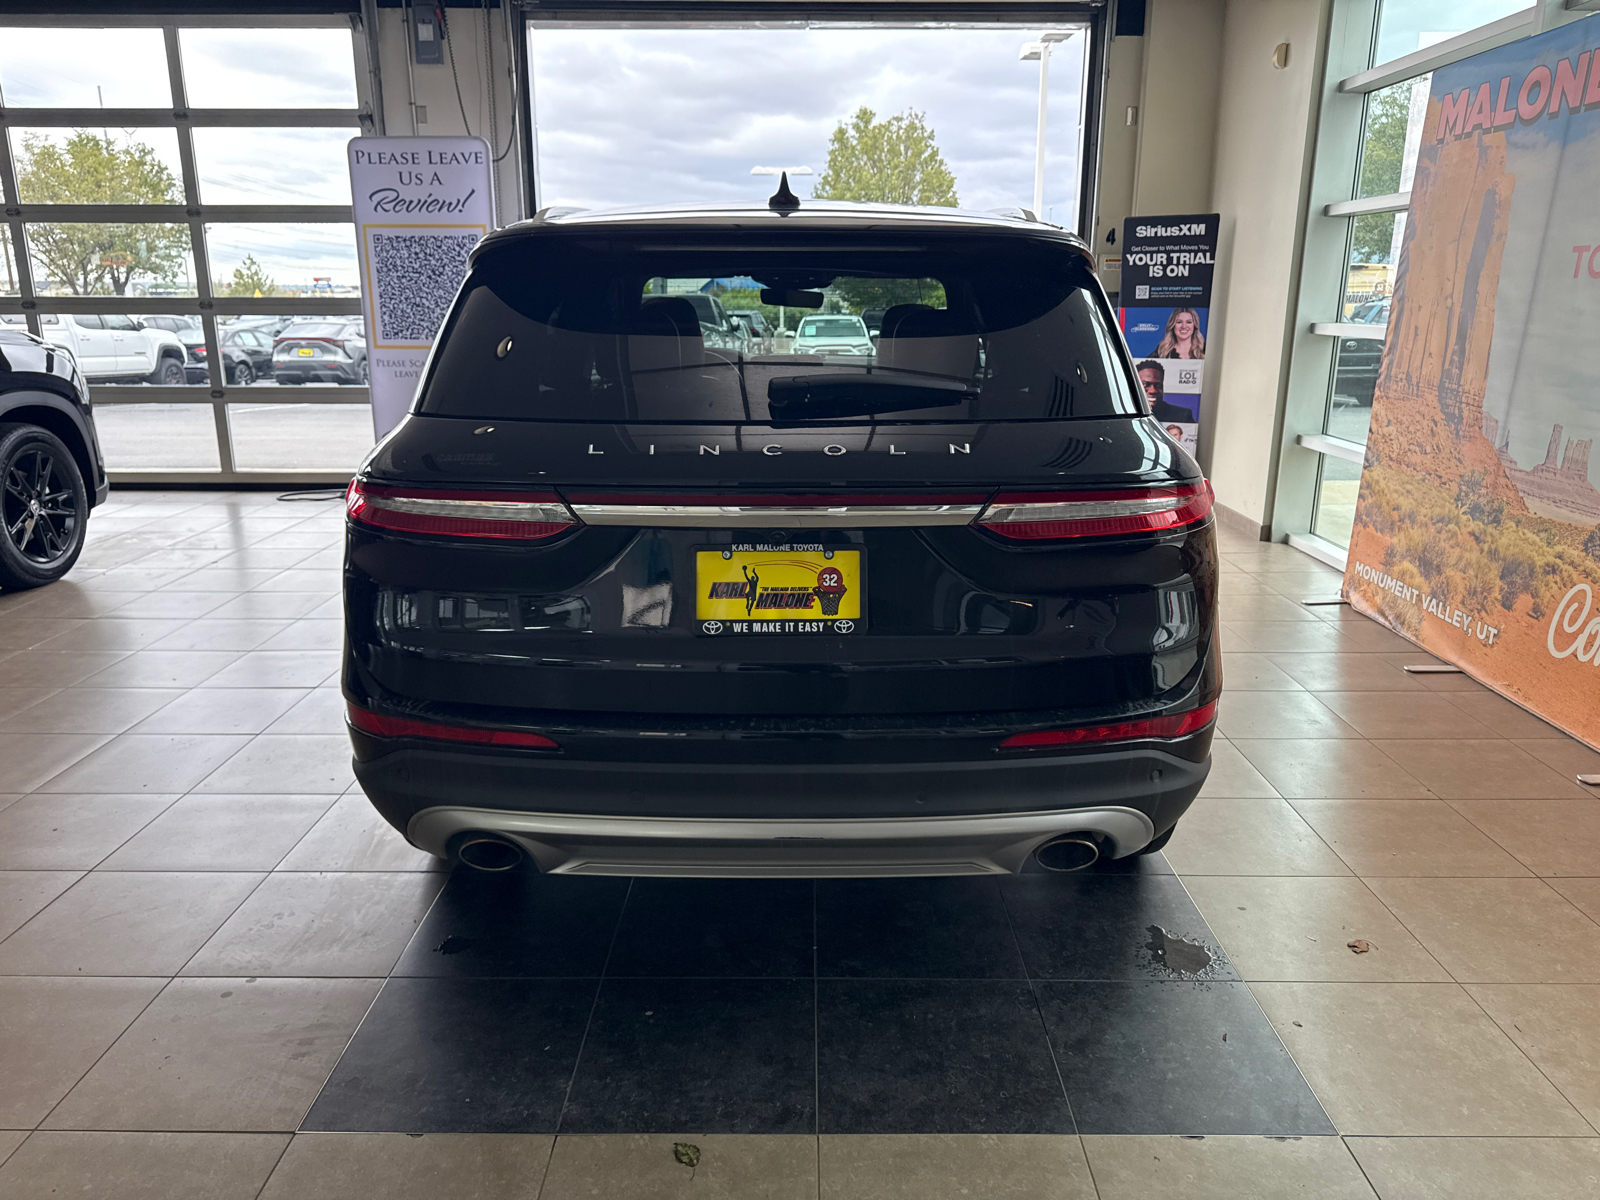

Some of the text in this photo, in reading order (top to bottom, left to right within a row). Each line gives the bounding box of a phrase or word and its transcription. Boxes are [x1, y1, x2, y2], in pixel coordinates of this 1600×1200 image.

[355, 150, 484, 165] PLEASE LEAVE
[398, 171, 444, 186] US A
[369, 188, 475, 213] Review!
[1105, 228, 1115, 245] 4
[1136, 224, 1205, 237] SiriusXM
[1126, 253, 1166, 265] YOUR
[1170, 252, 1215, 265] TRIAL
[1149, 265, 1189, 277] IS ON
[376, 359, 426, 367] PLEASE SCA
[1179, 371, 1197, 380] LOL
[588, 443, 971, 456] LINCOLN
[822, 574, 838, 587] 32
[708, 582, 748, 599] KARL
[755, 592, 815, 609] MALONE
[1354, 561, 1498, 644] MONUMENT VALLEY, UT
[732, 622, 824, 633] WE MAKE IT EASY
[1547, 583, 1600, 667] Co
